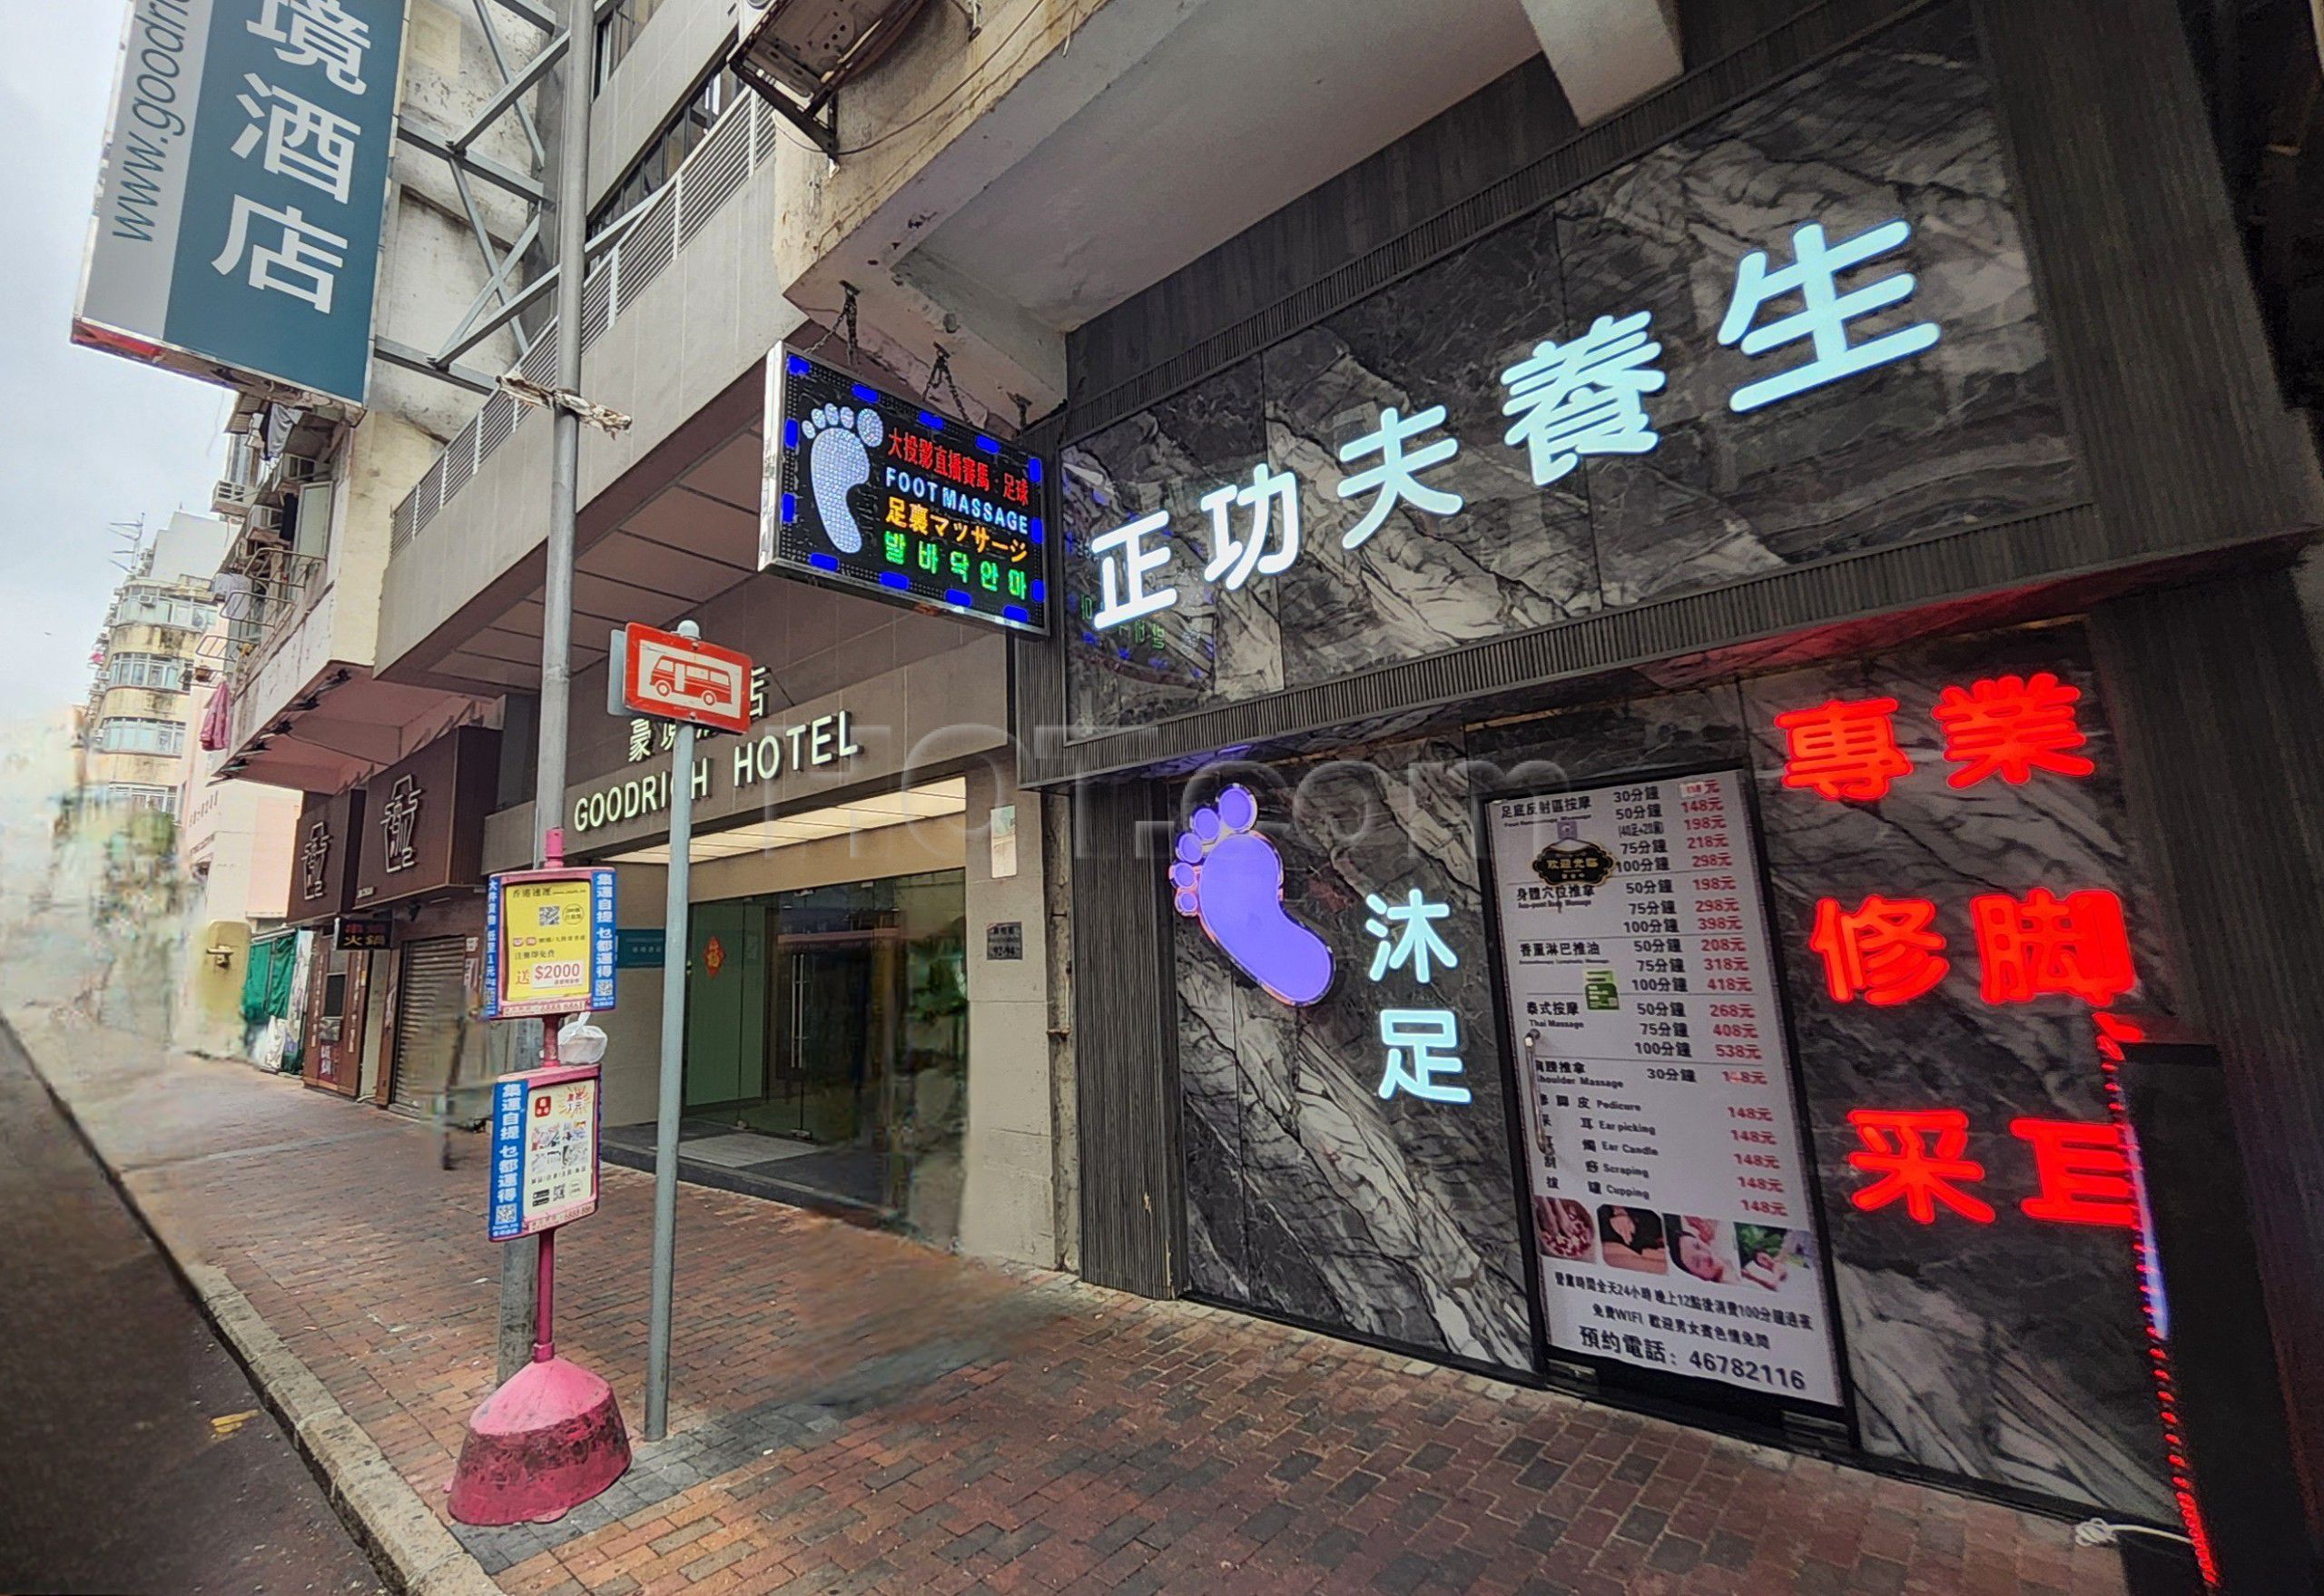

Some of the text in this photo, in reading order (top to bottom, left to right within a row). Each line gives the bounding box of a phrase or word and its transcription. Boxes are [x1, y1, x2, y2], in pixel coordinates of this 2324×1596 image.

[212, 0, 373, 315] 境酒店
[1091, 219, 1940, 631] 正功夫養生
[885, 466, 1029, 535] FOOT MASSAGE
[1775, 673, 2094, 801] 專業
[574, 710, 859, 832] GOODRIH HOTEL
[1681, 797, 1723, 813] 148元
[1684, 815, 1727, 831] 198元
[1687, 833, 1729, 849] 218元
[1692, 852, 1732, 867] 298元
[1692, 876, 1737, 891] 198元
[1695, 898, 1741, 912] 298元
[1698, 915, 1743, 931] 398元
[1701, 937, 1747, 951] 208元
[535, 963, 580, 980] $2000
[1703, 957, 1750, 971] 318元
[1707, 977, 1753, 991] 418元
[1366, 888, 1472, 1104] 沐足
[1709, 1003, 1756, 1019] 268元
[1713, 1023, 1758, 1039] 408元
[1716, 1044, 1762, 1059] 538元
[1537, 1075, 1623, 1089] houlder Massage
[1597, 1099, 1641, 1111] Pedicure
[1728, 1107, 1774, 1121] 148元
[1599, 1120, 1656, 1136] Ear picking
[1731, 1129, 1777, 1145] 148元
[1601, 1141, 1659, 1156] Ear Candle
[1734, 1153, 1780, 1169] 148元
[1603, 1163, 1649, 1179] Scraping
[1606, 1184, 1650, 1200] Cupping
[1738, 1177, 1785, 1193] 148元
[1741, 1199, 1788, 1217] 148元
[1689, 1350, 1806, 1391] 46782116
